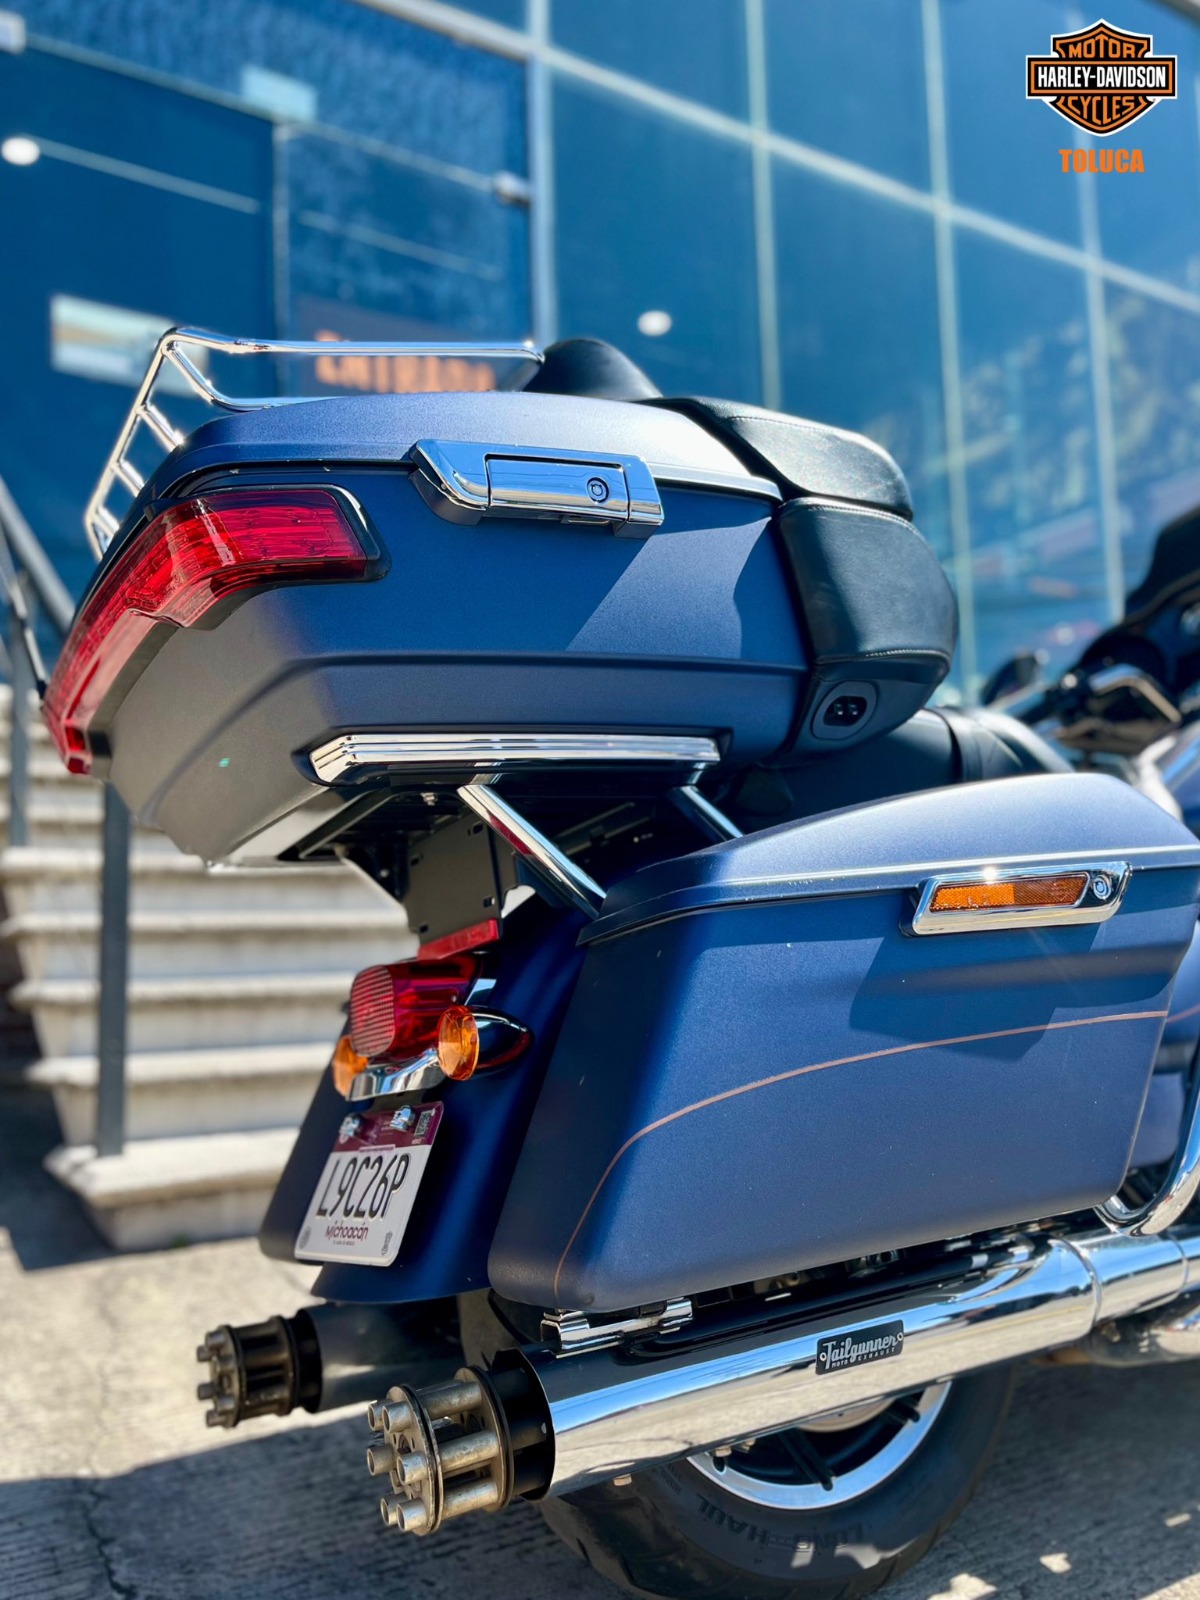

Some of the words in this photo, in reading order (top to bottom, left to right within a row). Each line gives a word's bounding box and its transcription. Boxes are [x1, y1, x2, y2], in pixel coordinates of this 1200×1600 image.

[316, 1152, 411, 1219] L9C26P
[822, 1335, 899, 1370] Tailgunner
[831, 1359, 848, 1368] MOTO
[857, 1347, 896, 1361] EXHAUST
